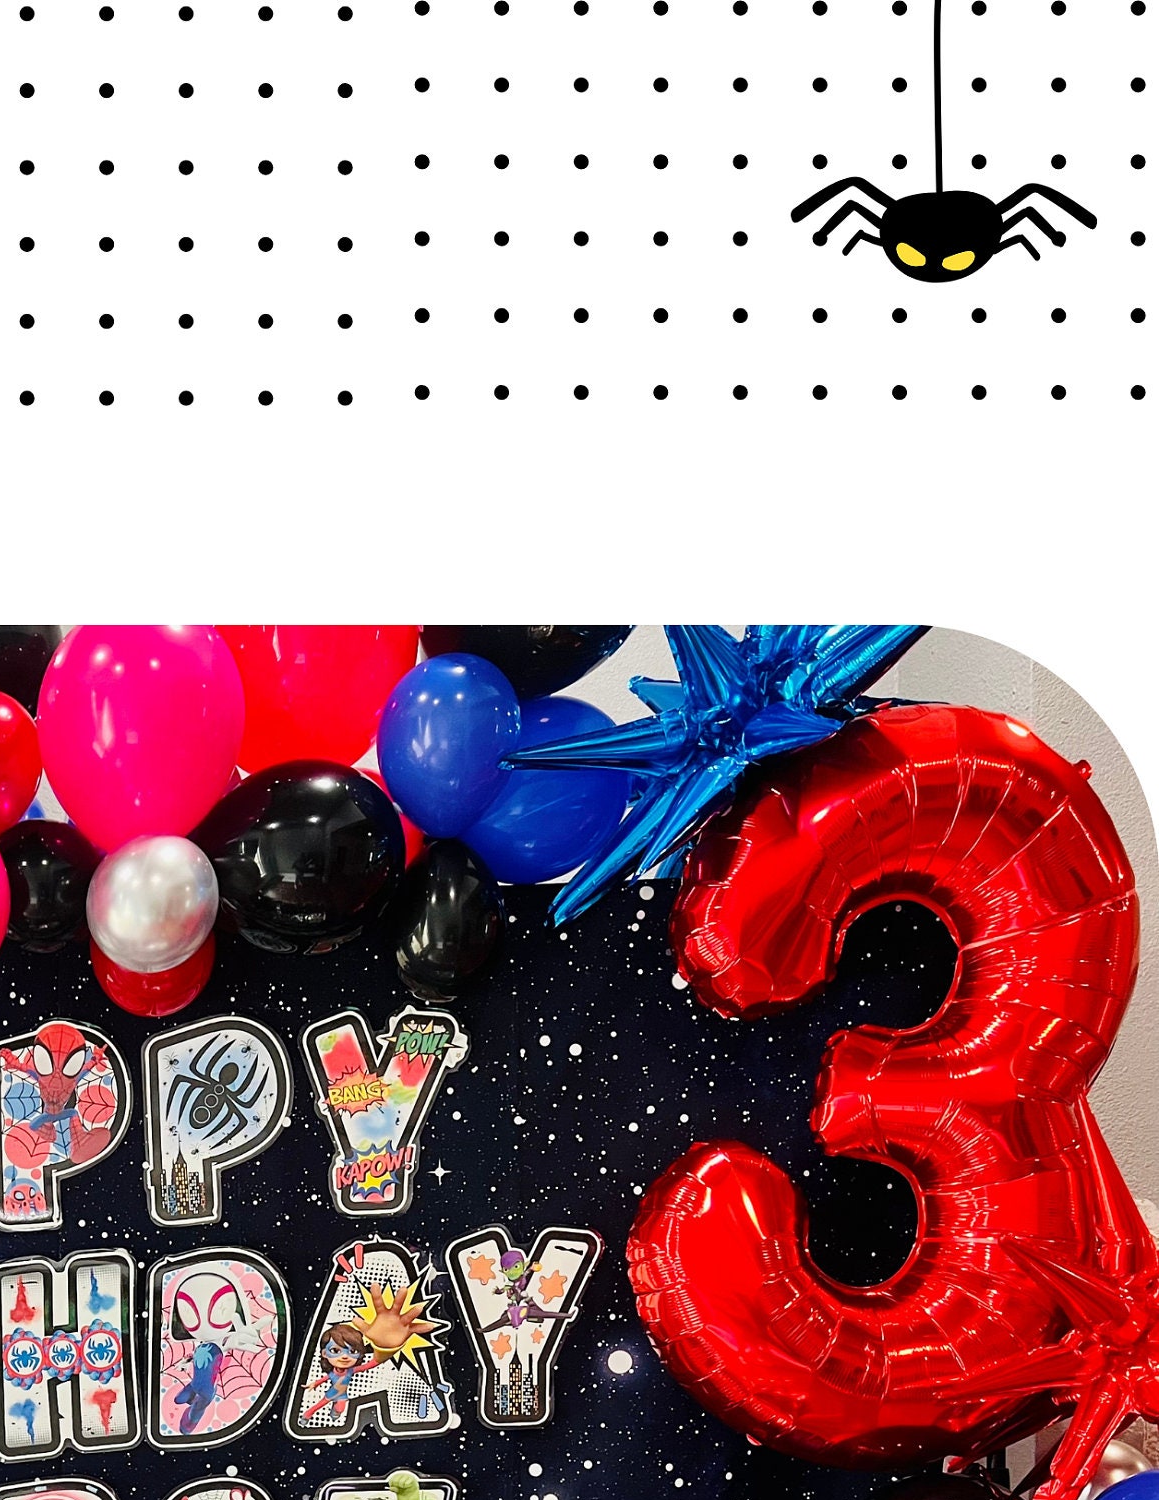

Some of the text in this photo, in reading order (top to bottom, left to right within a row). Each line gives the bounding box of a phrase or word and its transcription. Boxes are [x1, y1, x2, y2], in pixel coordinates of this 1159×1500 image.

[395, 1031, 450, 1055] POW!
[329, 1080, 383, 1106] BANG
[626, 703, 1140, 1470] 3
[336, 1146, 414, 1190] KAPOW!
